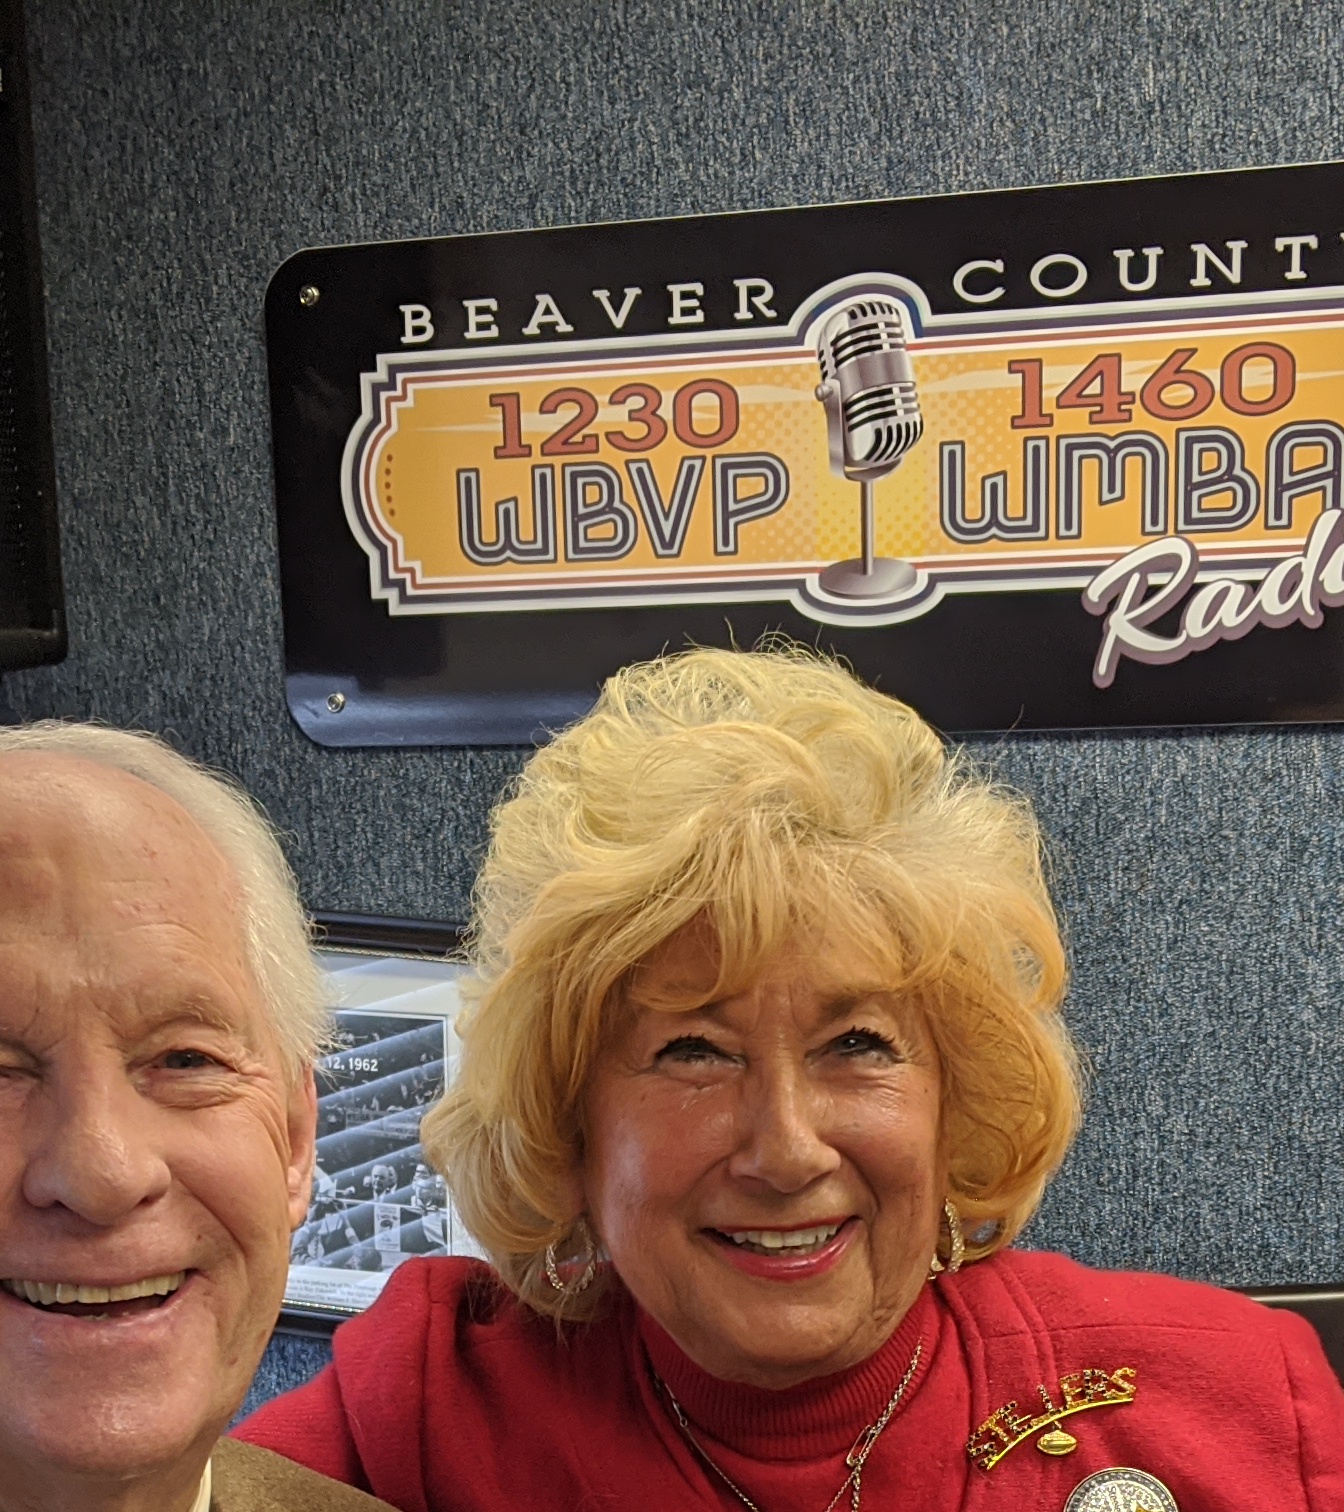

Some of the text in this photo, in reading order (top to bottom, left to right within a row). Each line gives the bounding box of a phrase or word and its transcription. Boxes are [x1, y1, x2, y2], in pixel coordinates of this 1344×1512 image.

[399, 277, 778, 344] BEAVER
[489, 341, 1296, 460] 1230 1460
[456, 452, 790, 566] WBVP
[348, 1057, 379, 1072] 1962
